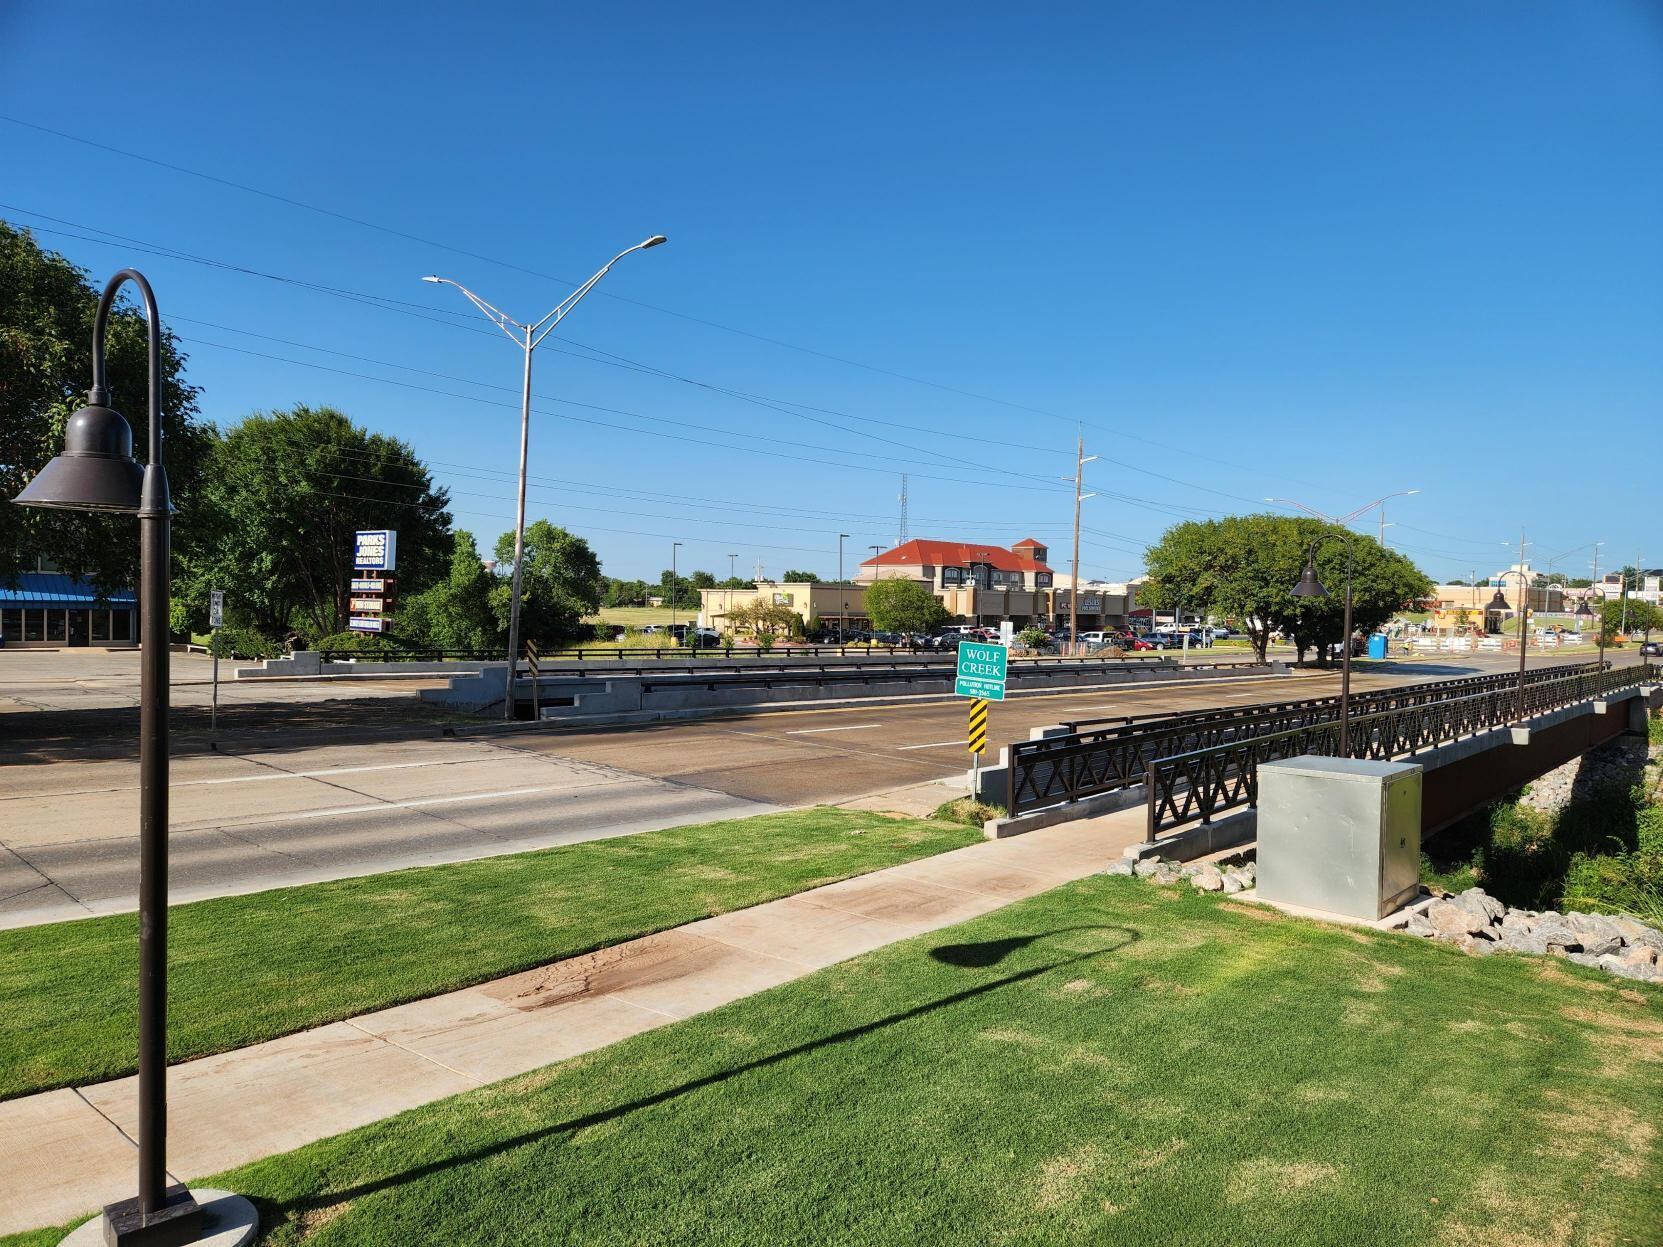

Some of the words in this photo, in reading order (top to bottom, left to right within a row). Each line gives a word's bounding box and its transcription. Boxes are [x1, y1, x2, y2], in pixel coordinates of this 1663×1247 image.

[356, 535, 385, 546] PARKS
[356, 546, 384, 557] JONES
[355, 556, 384, 565] REALTORS
[966, 649, 1001, 662] WOLF
[961, 661, 1001, 677] CREEK
[959, 680, 982, 689] POLLUTION
[983, 683, 1001, 691] HOTLINE
